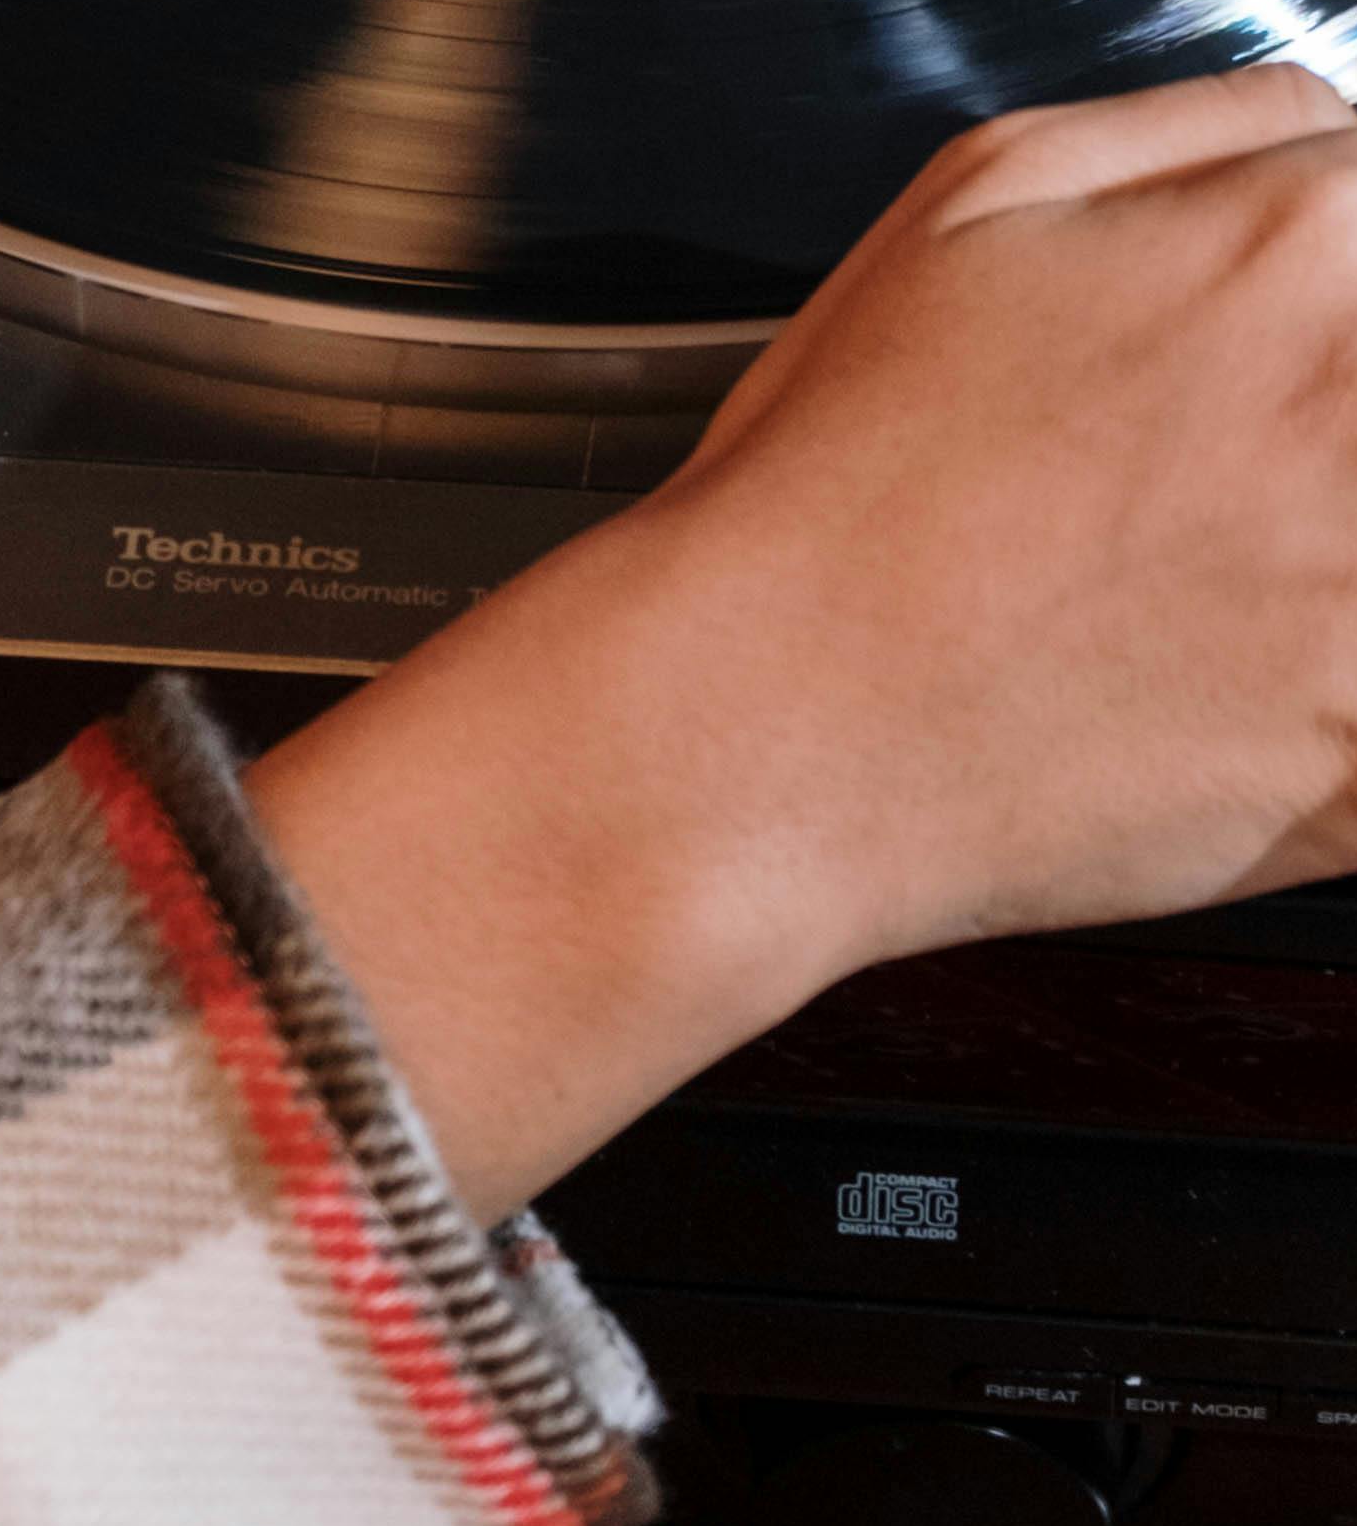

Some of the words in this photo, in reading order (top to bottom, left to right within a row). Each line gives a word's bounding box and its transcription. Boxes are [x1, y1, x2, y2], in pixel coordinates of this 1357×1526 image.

[111, 526, 360, 573] Technics
[105, 567, 155, 590] DC
[173, 570, 269, 596] Servo
[286, 577, 449, 606] Automatic
[875, 1173, 959, 1189] COMPACT
[837, 1171, 959, 1227] disc
[837, 1222, 900, 1238] DIGITAL
[904, 1226, 959, 1240] AUDIO
[984, 1383, 1081, 1403] REPEAT
[1125, 1398, 1179, 1416] EDIT
[1191, 1403, 1268, 1420] MODE
